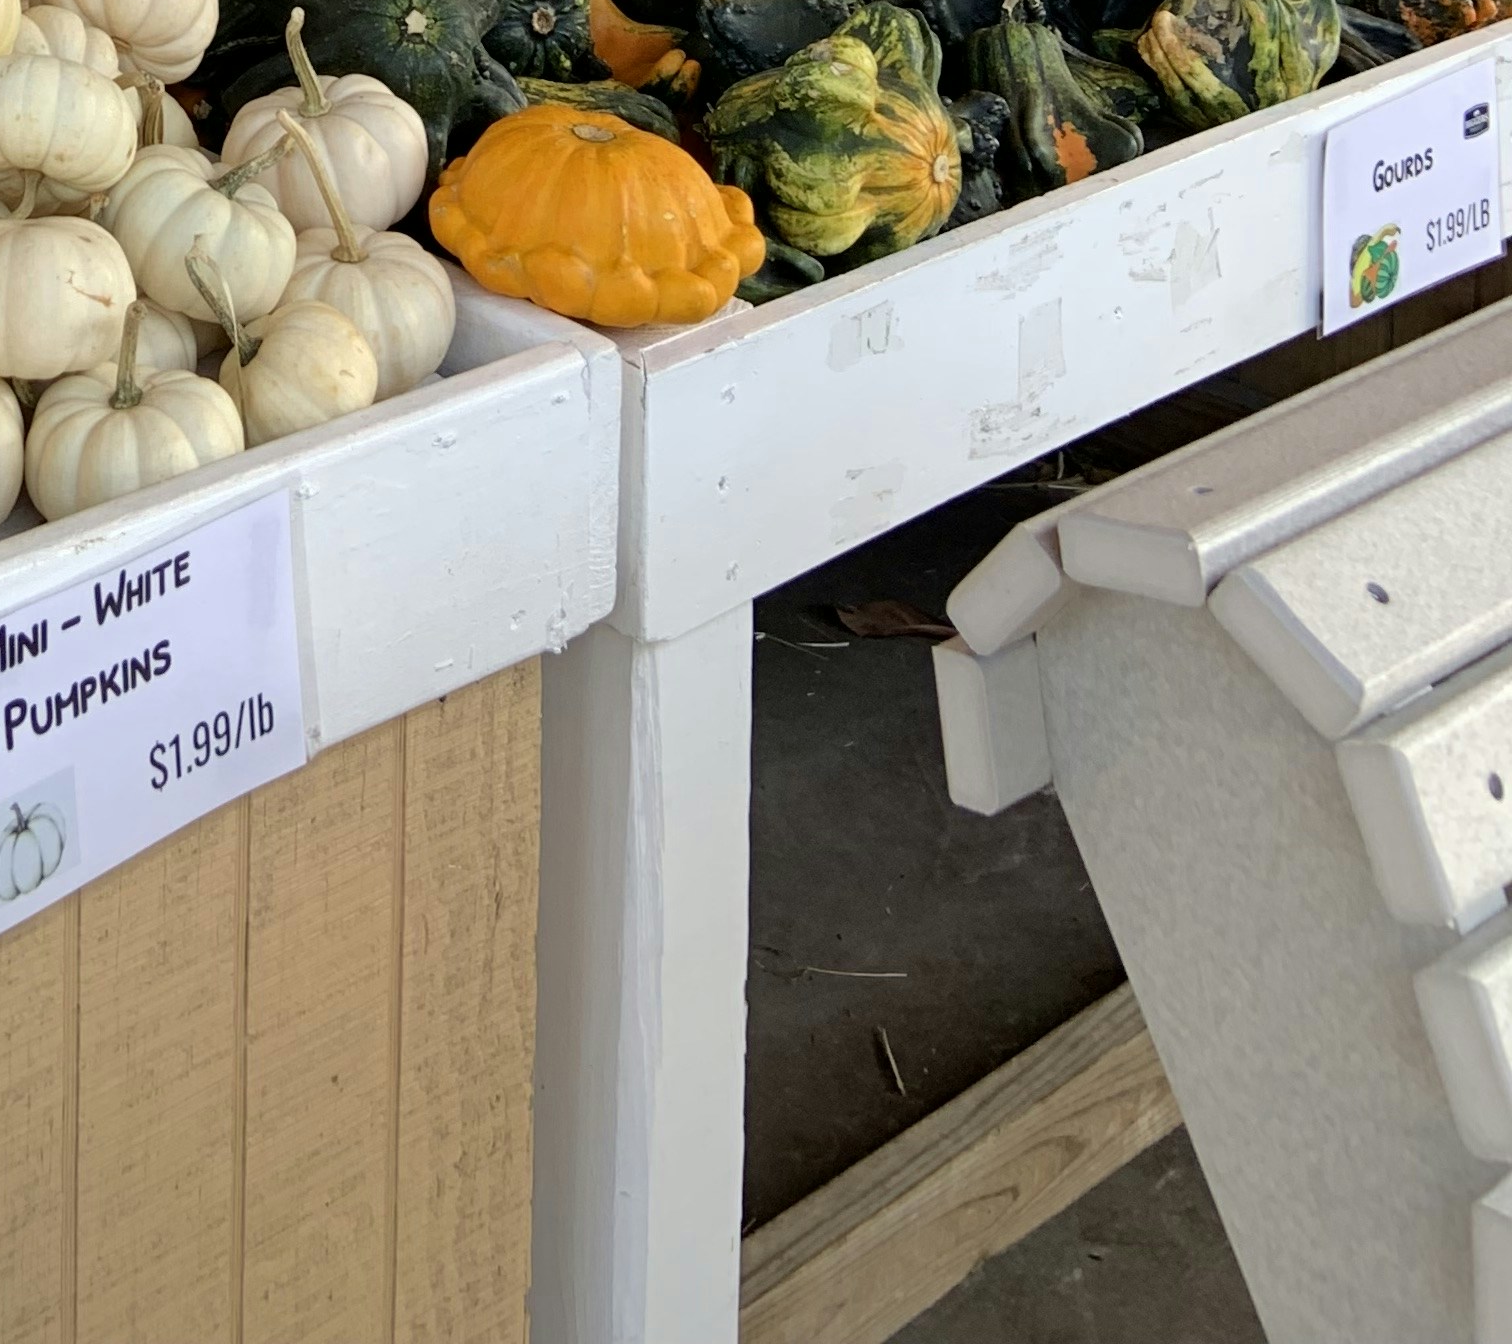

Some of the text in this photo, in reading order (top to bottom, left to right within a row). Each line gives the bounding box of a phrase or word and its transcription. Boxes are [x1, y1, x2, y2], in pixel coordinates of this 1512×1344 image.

[1373, 148, 1434, 192] GOURDS
[1426, 198, 1490, 252] $1.99/LB
[94, 551, 191, 626] WHITE
[3, 639, 173, 751] PUMPKINS
[149, 693, 274, 792] $1.99/lb
